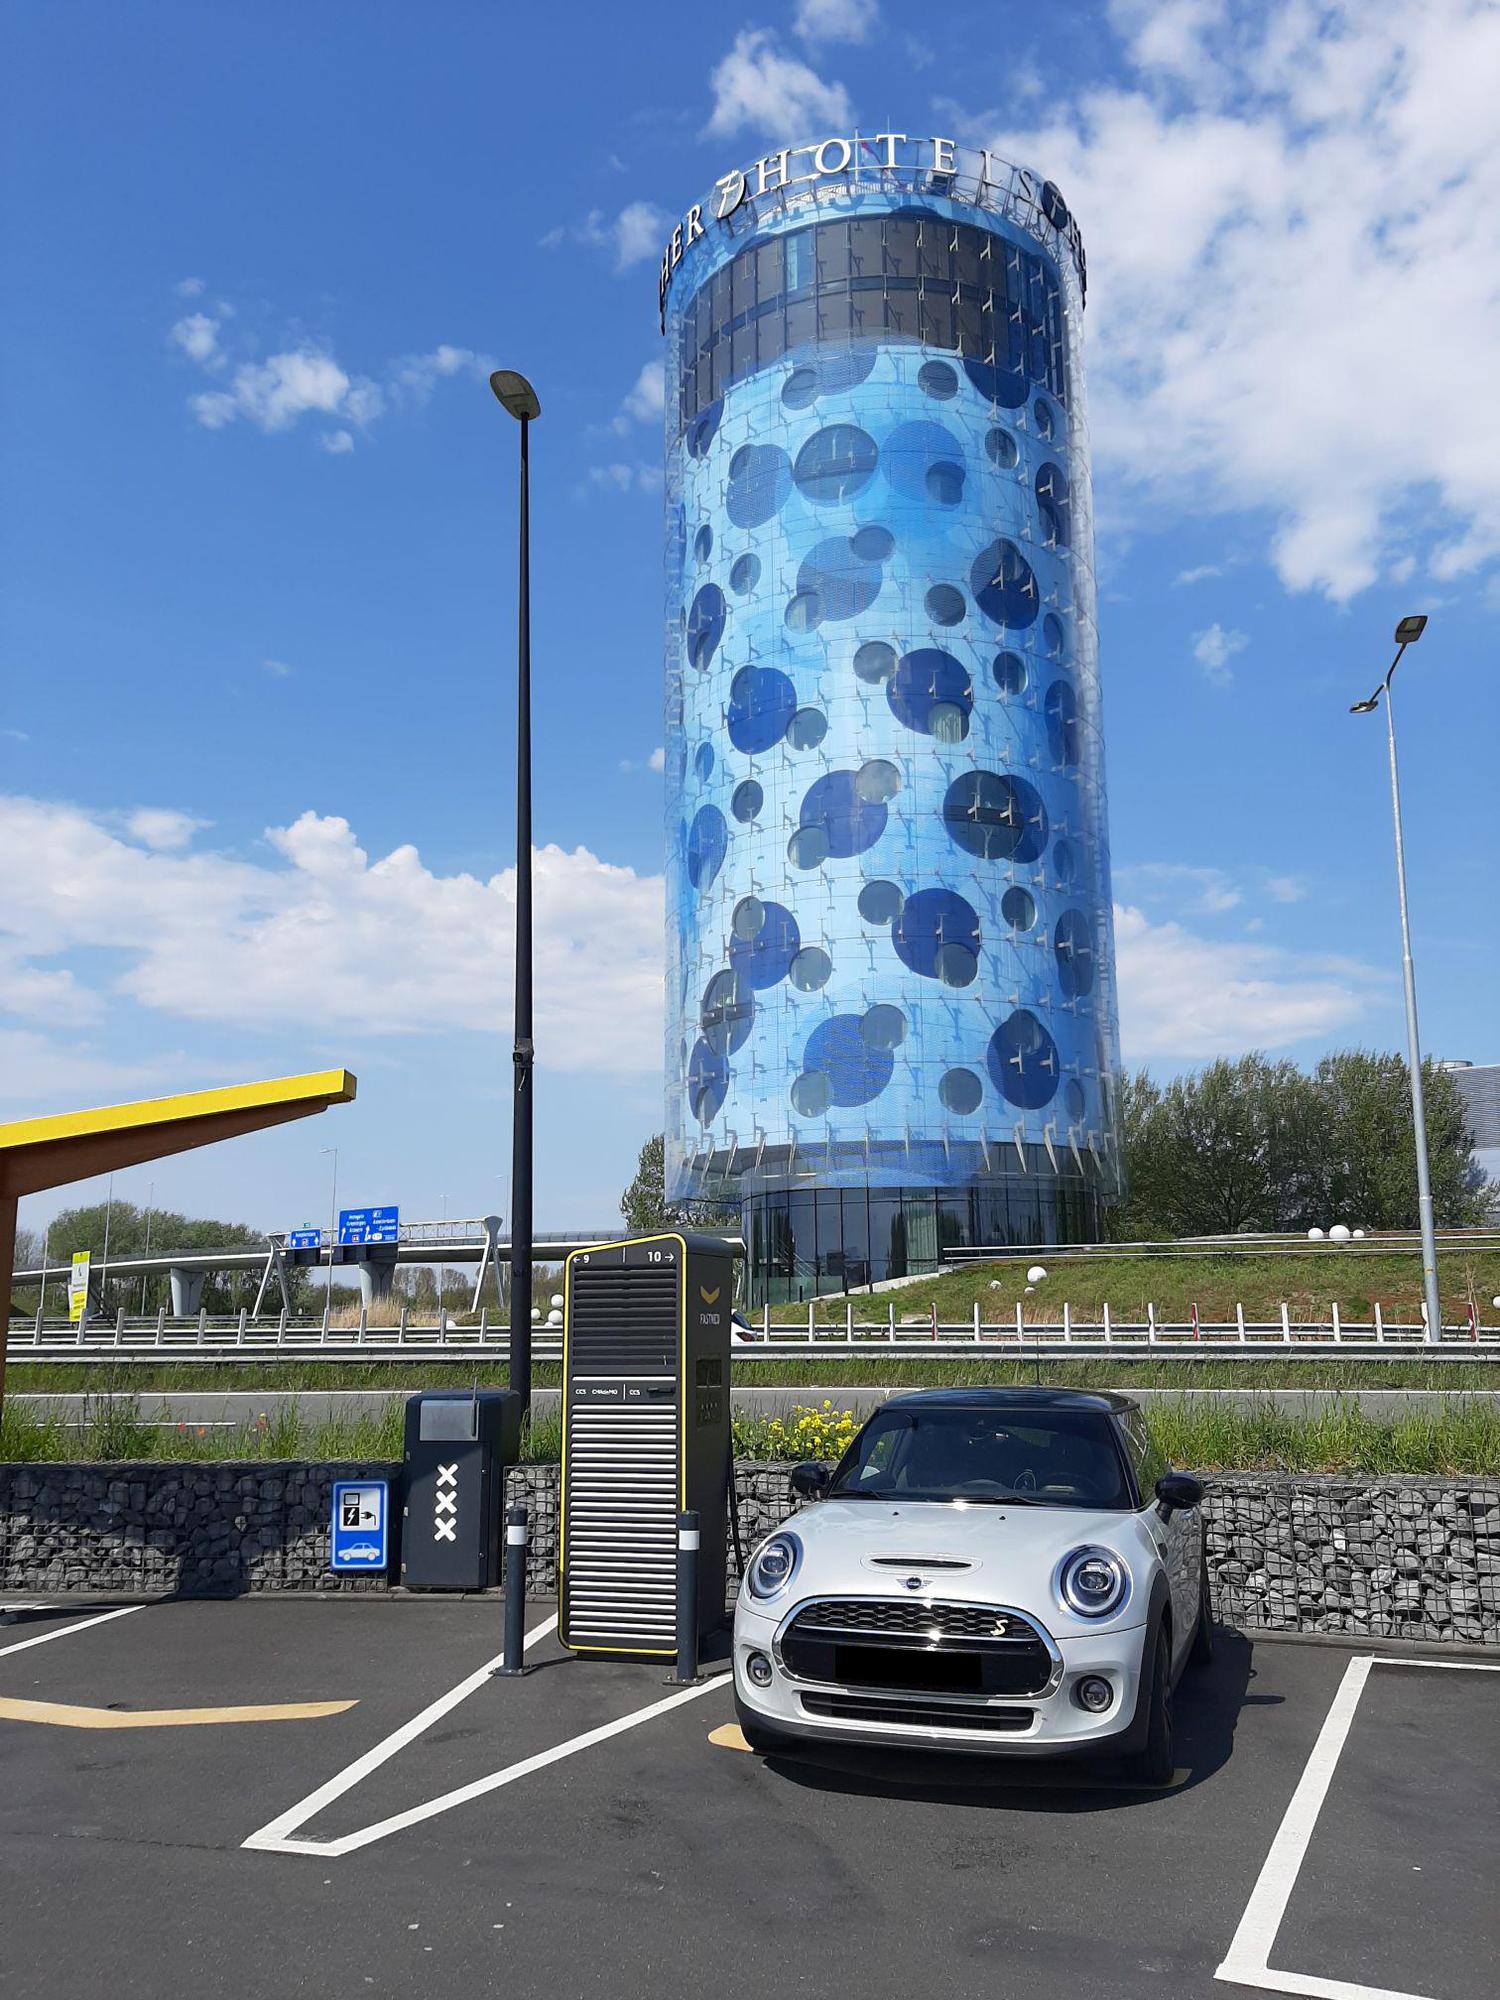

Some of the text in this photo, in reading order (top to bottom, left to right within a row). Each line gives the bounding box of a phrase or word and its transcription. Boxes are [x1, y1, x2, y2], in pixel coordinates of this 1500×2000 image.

[754, 133, 1036, 201] HOTELS
[583, 1254, 590, 1264] 9
[647, 1251, 662, 1263] 10
[990, 1619, 1009, 1636] S
